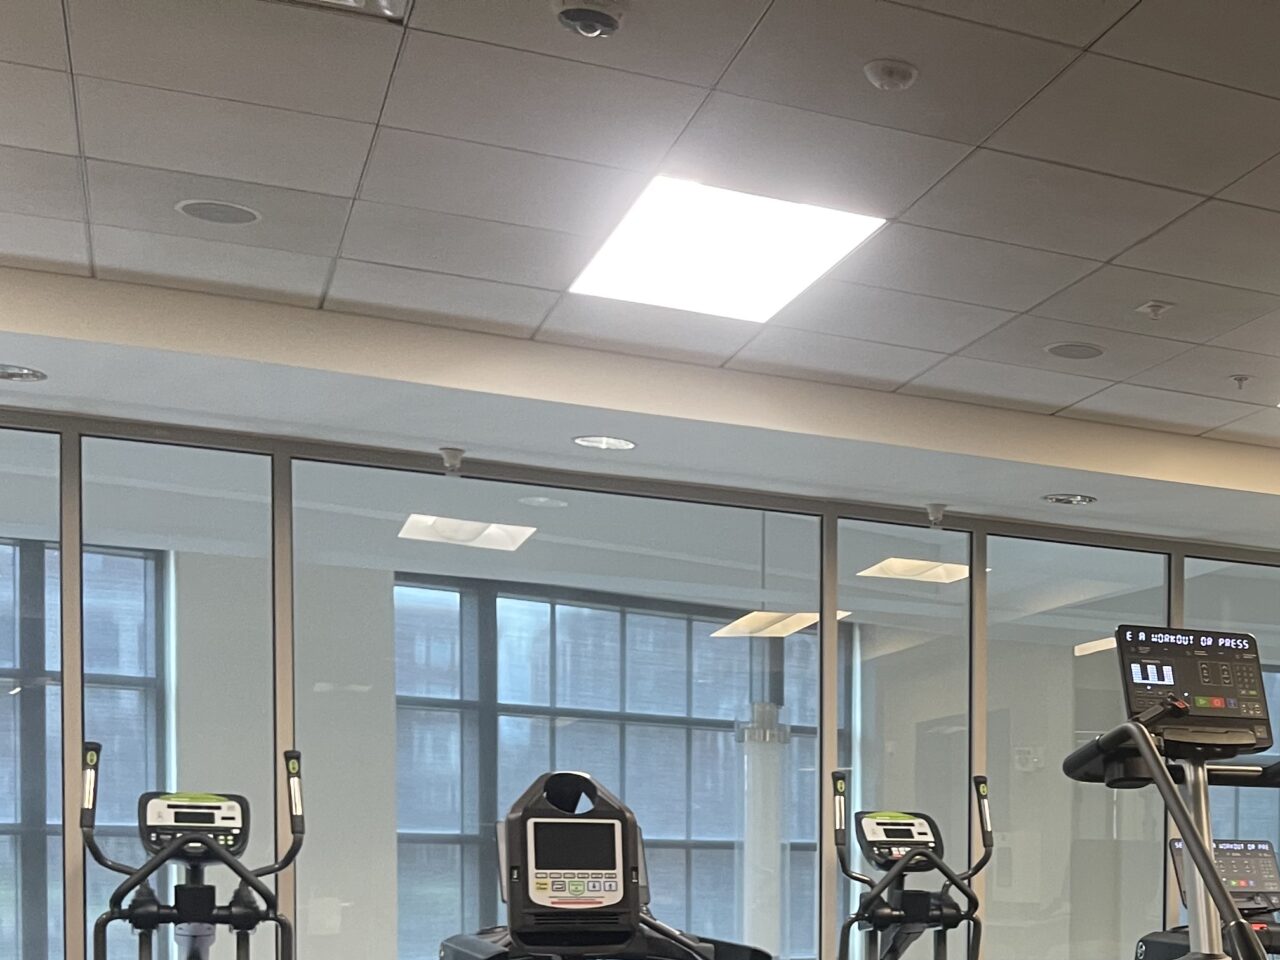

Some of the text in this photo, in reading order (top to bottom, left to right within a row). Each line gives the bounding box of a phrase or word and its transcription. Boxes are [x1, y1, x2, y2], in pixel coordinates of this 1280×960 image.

[1138, 632, 1146, 641] A
[1151, 633, 1194, 645] WORKOUT
[1200, 636, 1213, 647] OR
[1218, 637, 1249, 649] PRESS
